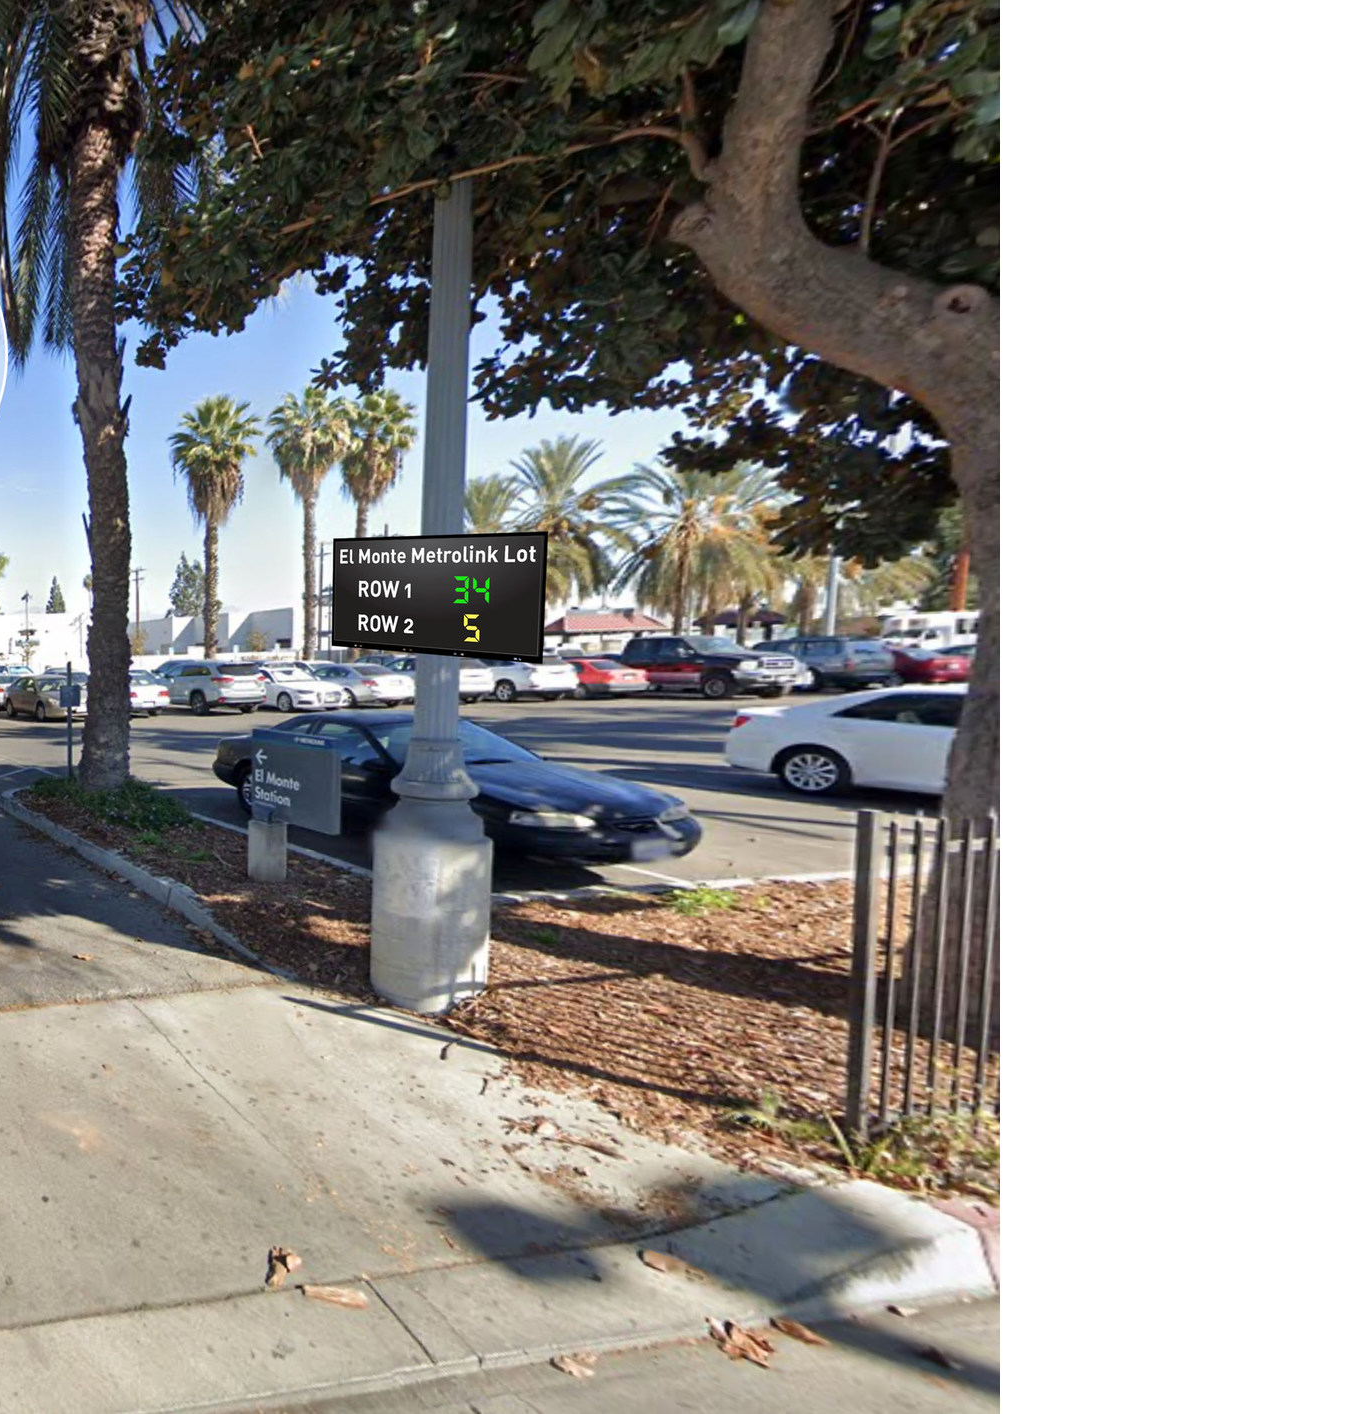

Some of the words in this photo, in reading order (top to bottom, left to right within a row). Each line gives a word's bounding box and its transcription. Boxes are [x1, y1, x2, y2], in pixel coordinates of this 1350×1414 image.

[339, 548, 354, 564] El
[358, 548, 406, 564] Monte
[411, 545, 498, 564] Metrolink
[504, 545, 536, 563] Lot
[358, 580, 400, 598] ROW
[404, 583, 412, 598] 1
[453, 575, 491, 604] 34
[358, 614, 399, 633] ROW
[403, 618, 414, 634] 2
[463, 613, 480, 643] 5
[255, 768, 264, 782] El
[266, 771, 300, 791] Monte
[254, 786, 291, 807] Station
